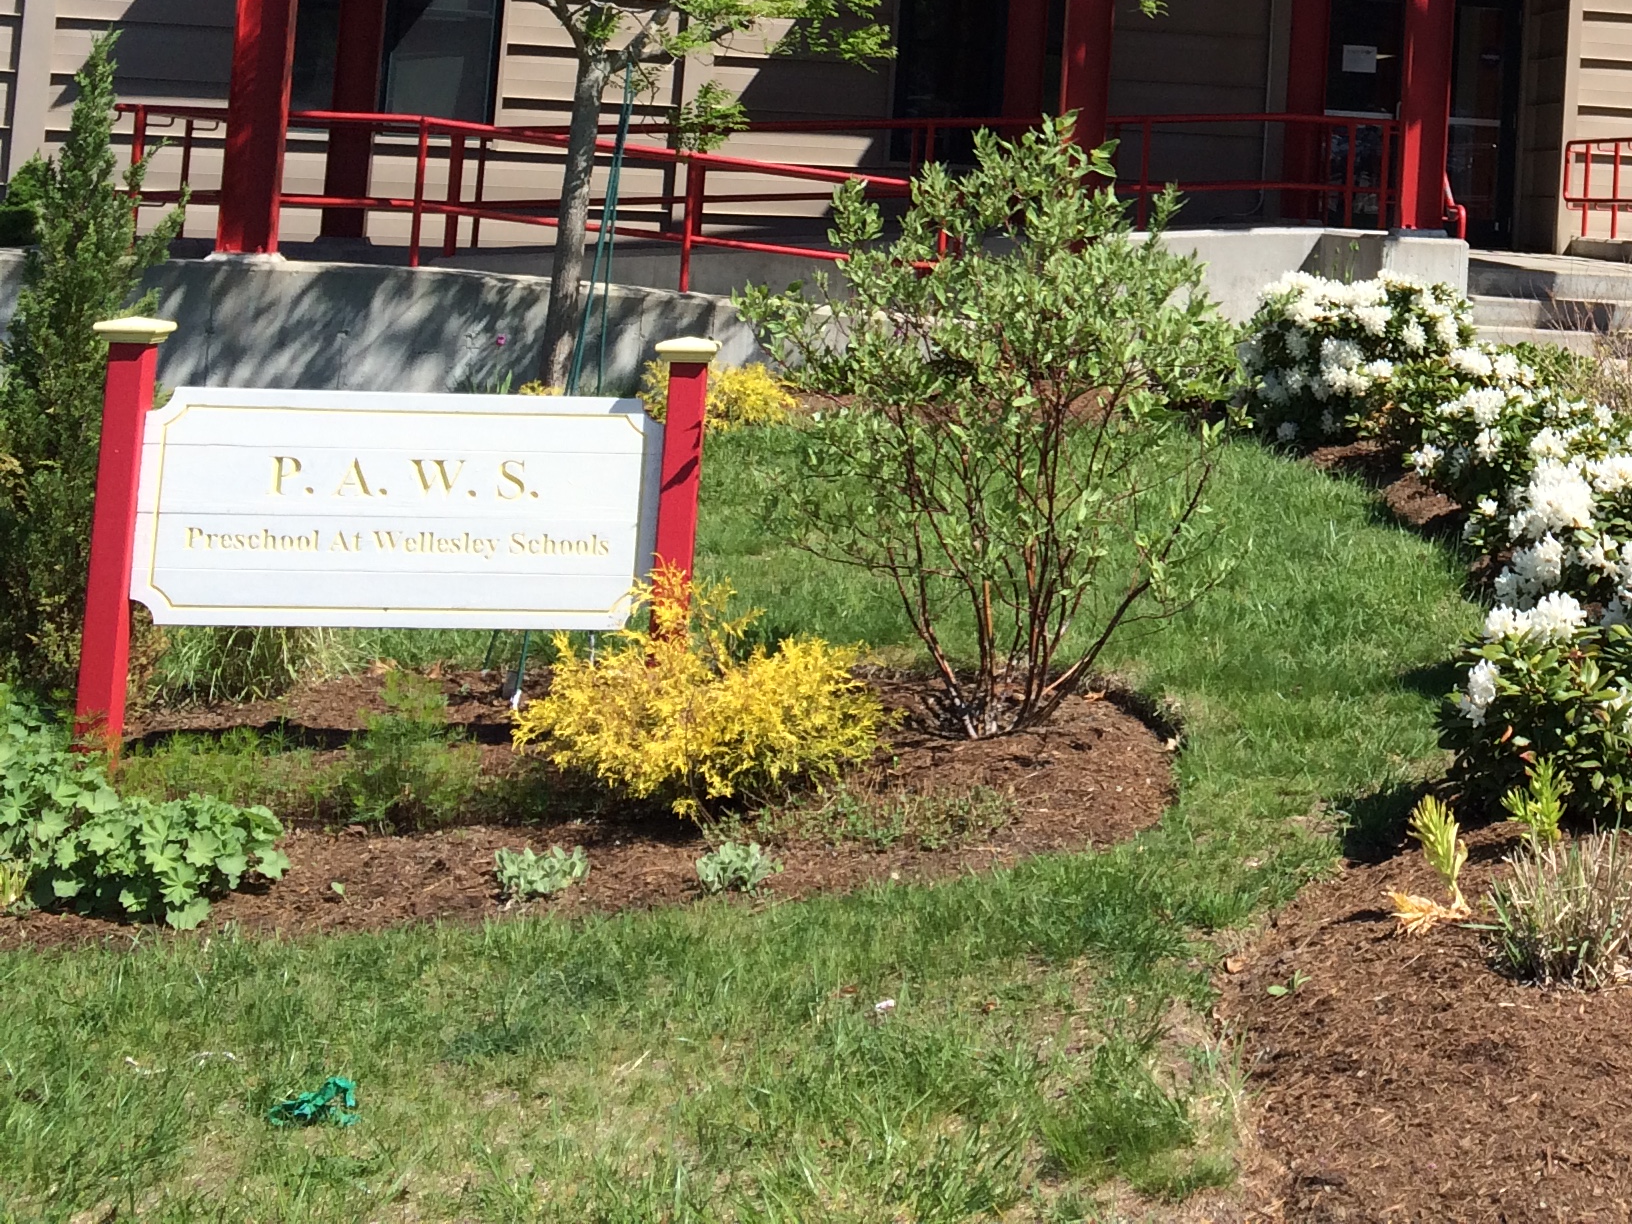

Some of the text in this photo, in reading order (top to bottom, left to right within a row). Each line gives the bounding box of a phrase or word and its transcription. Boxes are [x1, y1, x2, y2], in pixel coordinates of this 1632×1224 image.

[184, 527, 610, 559] Preschool At Wellesley Schools
